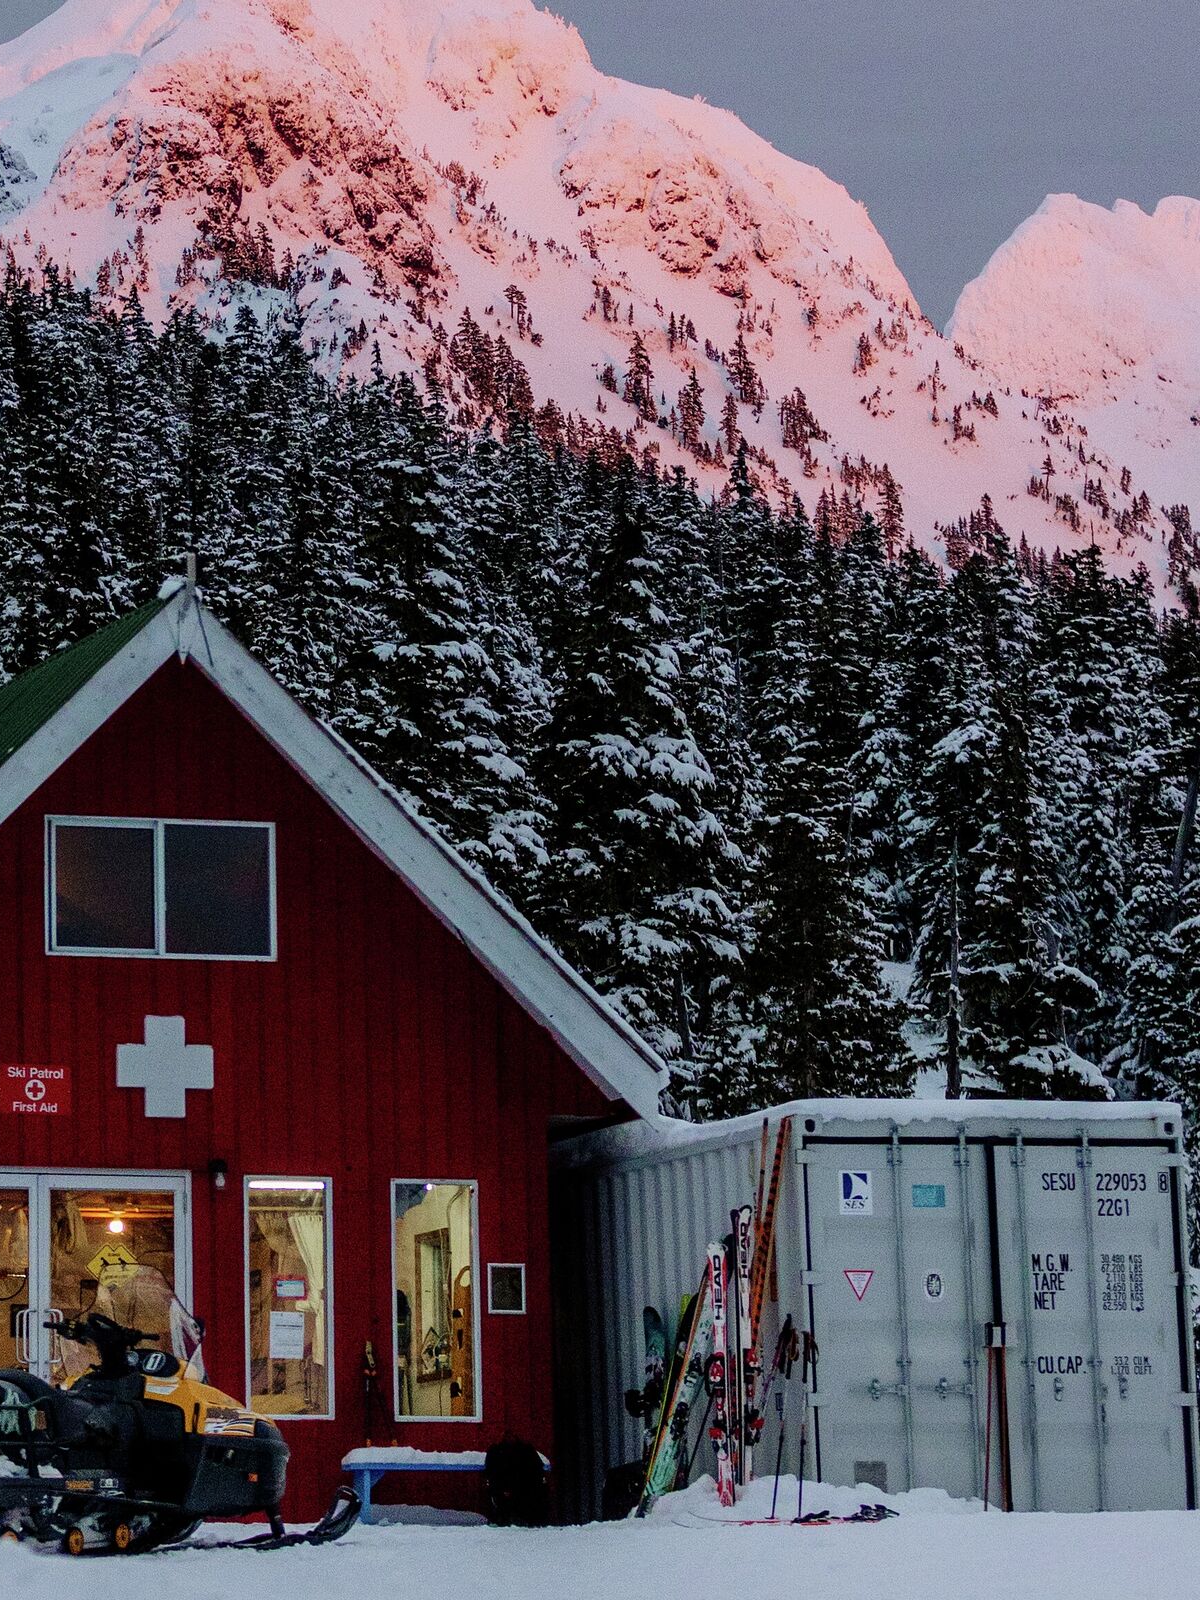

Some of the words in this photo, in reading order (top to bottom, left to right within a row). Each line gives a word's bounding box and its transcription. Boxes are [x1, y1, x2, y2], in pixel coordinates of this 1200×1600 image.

[8, 1066, 26, 1078] Ski
[29, 1067, 64, 1079] Patrol
[12, 1101, 37, 1112] First
[39, 1102, 58, 1113] Aid
[1041, 1172, 1076, 1191] SESU
[1095, 1173, 1147, 1191] 229053
[1159, 1173, 1168, 1191] 8
[844, 1200, 866, 1209] SES
[1097, 1198, 1130, 1217] 22G1
[739, 1221, 749, 1279] HEAD
[1031, 1253, 1073, 1272] M.G.W.
[712, 1254, 723, 1321] HEAD
[1032, 1272, 1066, 1291] TARE
[1033, 1291, 1056, 1310] NET
